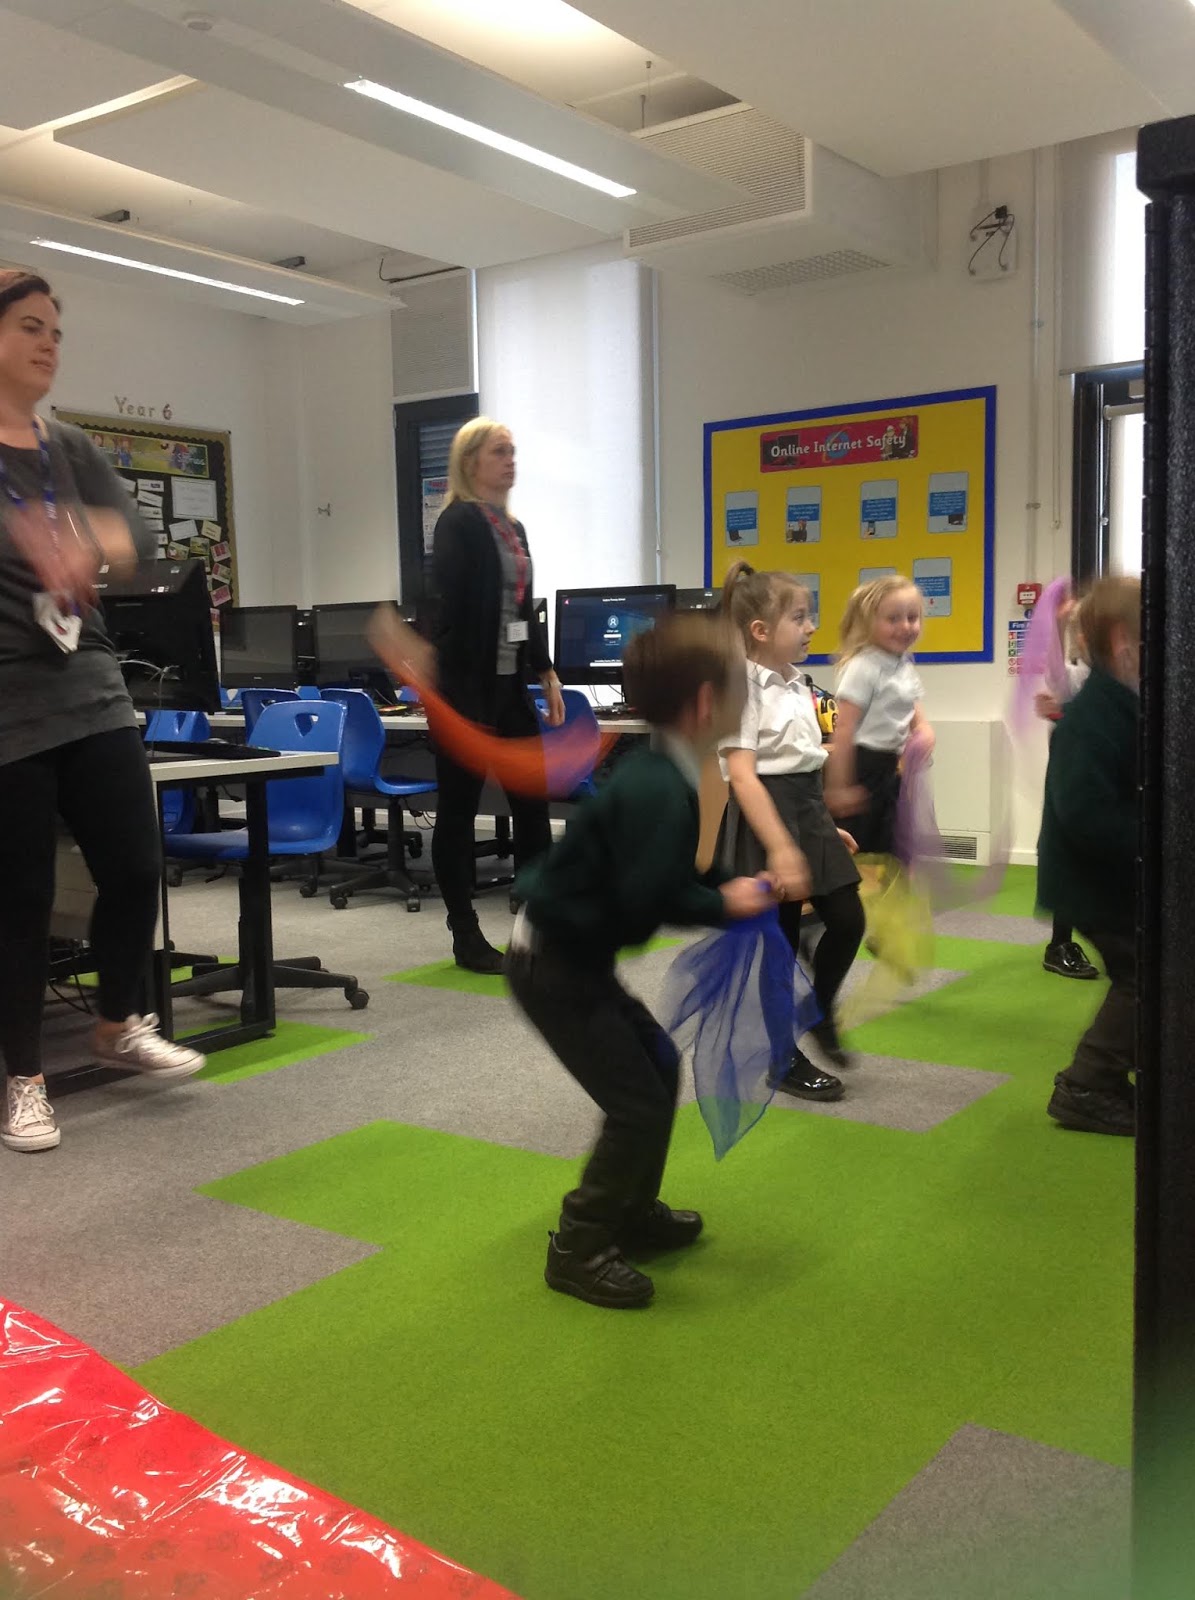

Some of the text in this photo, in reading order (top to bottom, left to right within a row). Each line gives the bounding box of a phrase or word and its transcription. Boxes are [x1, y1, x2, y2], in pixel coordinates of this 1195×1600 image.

[114, 395, 173, 420] Year 6
[771, 434, 907, 457] Online Internet Safety
